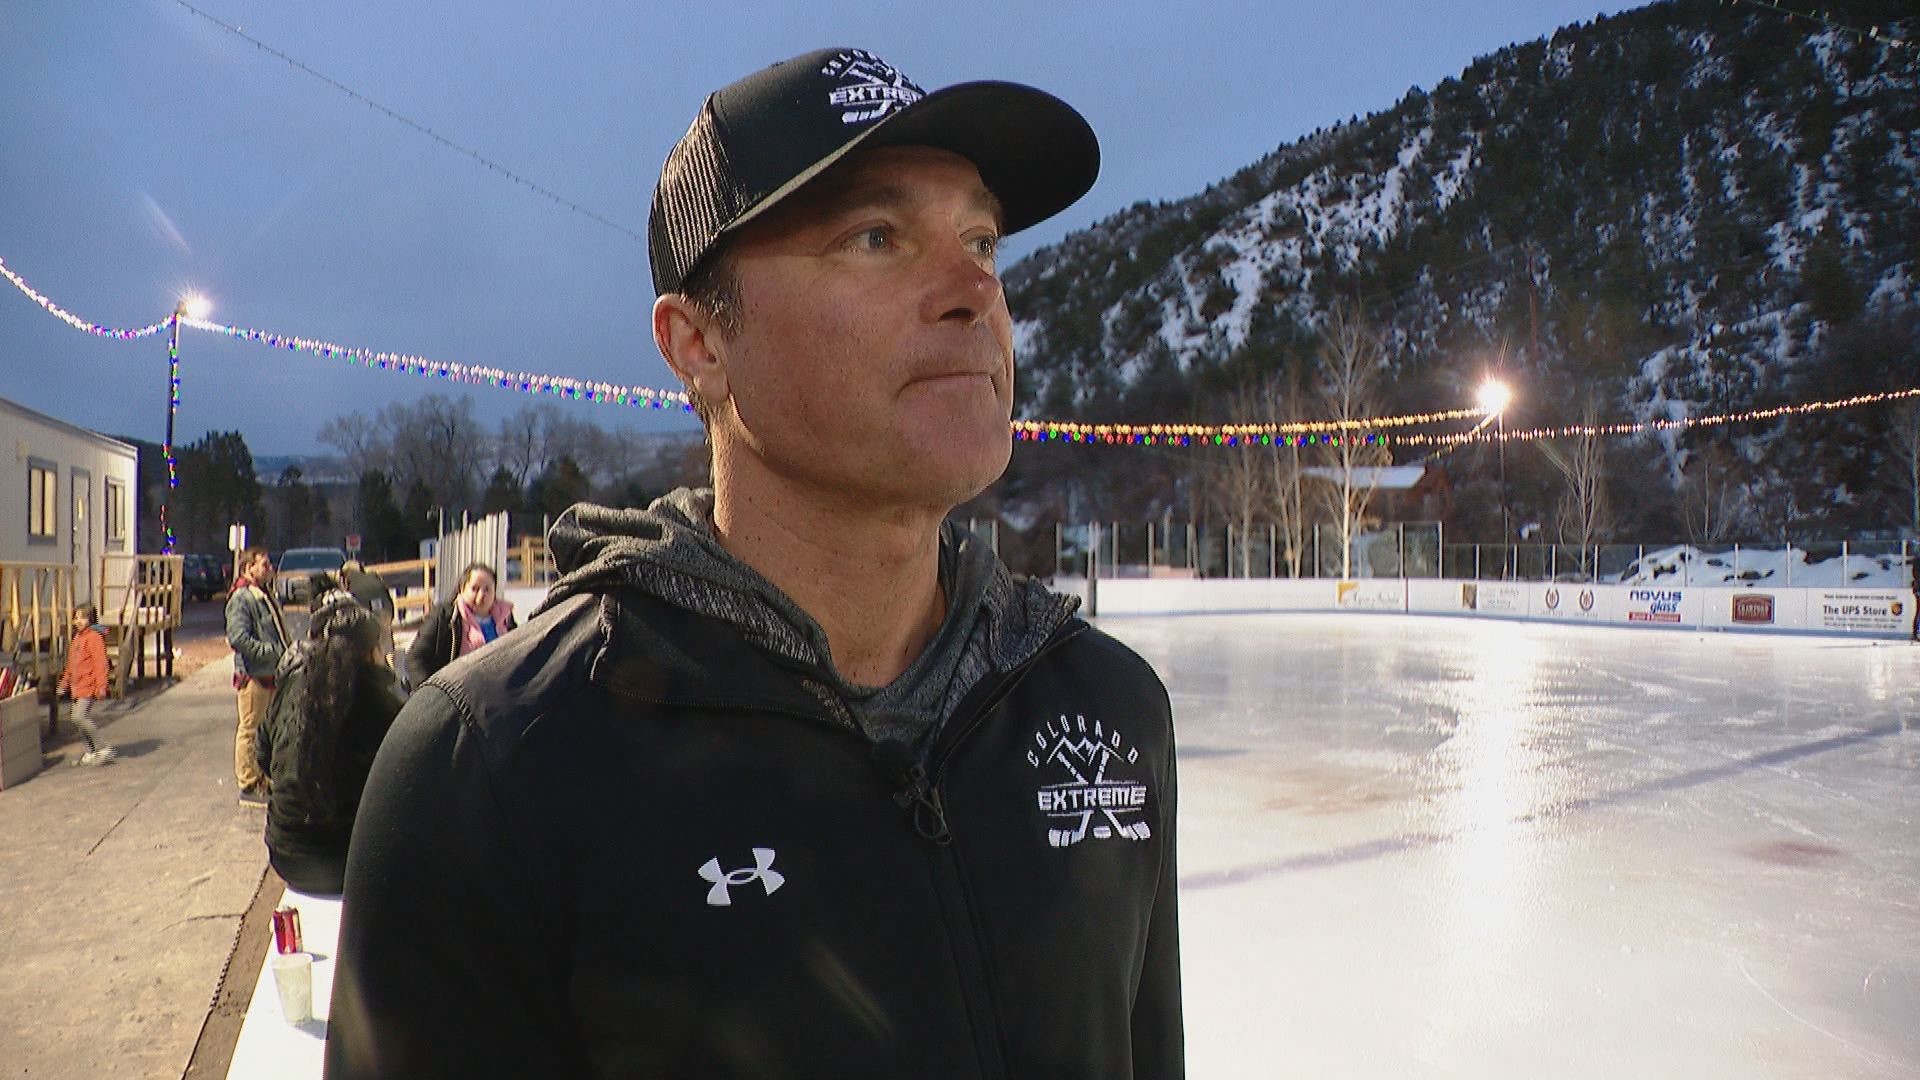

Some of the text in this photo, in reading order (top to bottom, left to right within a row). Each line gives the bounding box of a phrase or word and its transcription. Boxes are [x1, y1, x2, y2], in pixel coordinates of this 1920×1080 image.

[1650, 599, 1678, 615] glass
[1824, 605, 1888, 617] The UPS Store
[1027, 714, 1140, 769] COLORADO
[1037, 786, 1147, 811] EXTREME
